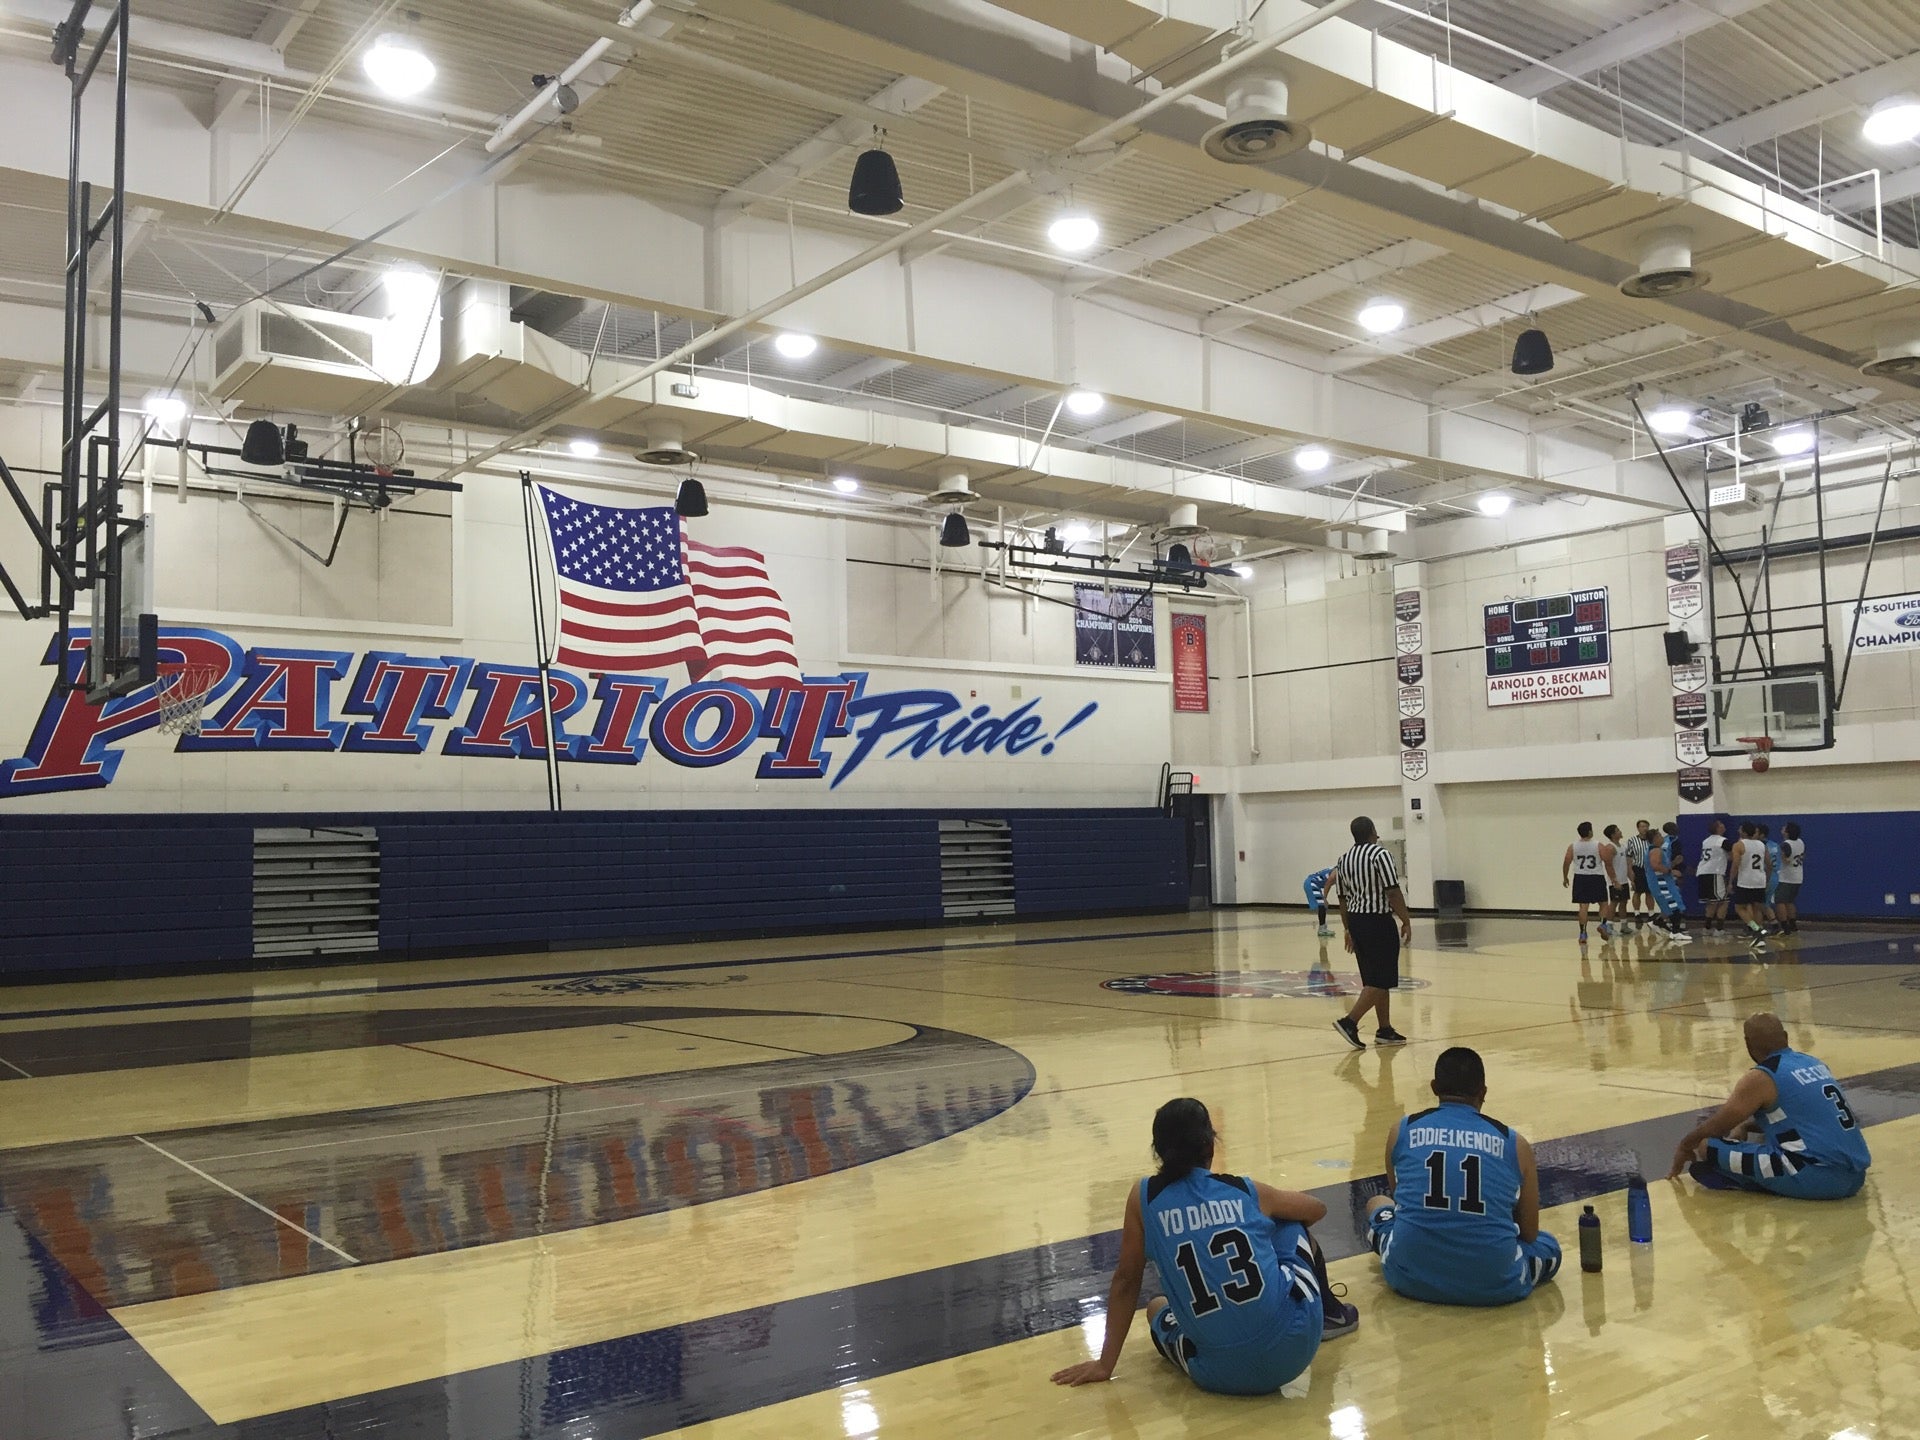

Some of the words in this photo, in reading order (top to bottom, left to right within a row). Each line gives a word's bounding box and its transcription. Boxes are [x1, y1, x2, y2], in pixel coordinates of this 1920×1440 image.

[1574, 590, 1604, 602] VISITOR
[1488, 605, 1509, 615] HOME
[1076, 620, 1113, 630] CHAMPIONS
[1117, 623, 1152, 633] CHAMPIONS
[1528, 627, 1548, 635] PERIOD
[1574, 625, 1593, 633] BONUS
[1497, 635, 1515, 643] BONUS
[1526, 642, 1547, 650] PLAYER
[1550, 639, 1568, 647] FOULS
[1579, 635, 1597, 643] FOULS
[1495, 646, 1511, 654] FOULS
[1490, 678, 1534, 691] ARNOLD
[1537, 676, 1549, 686] O.
[1552, 669, 1607, 685] BECKMAN
[1511, 690, 1538, 701] HIGH
[1540, 685, 1584, 697] SCHOOL
[0, 626, 868, 798] PATRIOT
[830, 689, 1099, 790] Pride!
[1577, 855, 1597, 869] 73
[1751, 854, 1762, 869] 2
[1791, 1066, 1817, 1085] ICE
[1822, 1083, 1856, 1131] 3
[1409, 1127, 1504, 1159] EDDIE1KENOBI
[1424, 1150, 1486, 1216] 11
[1158, 1208, 1184, 1237] YO
[1186, 1199, 1245, 1231] DADDY
[1175, 1227, 1265, 1318] 13
